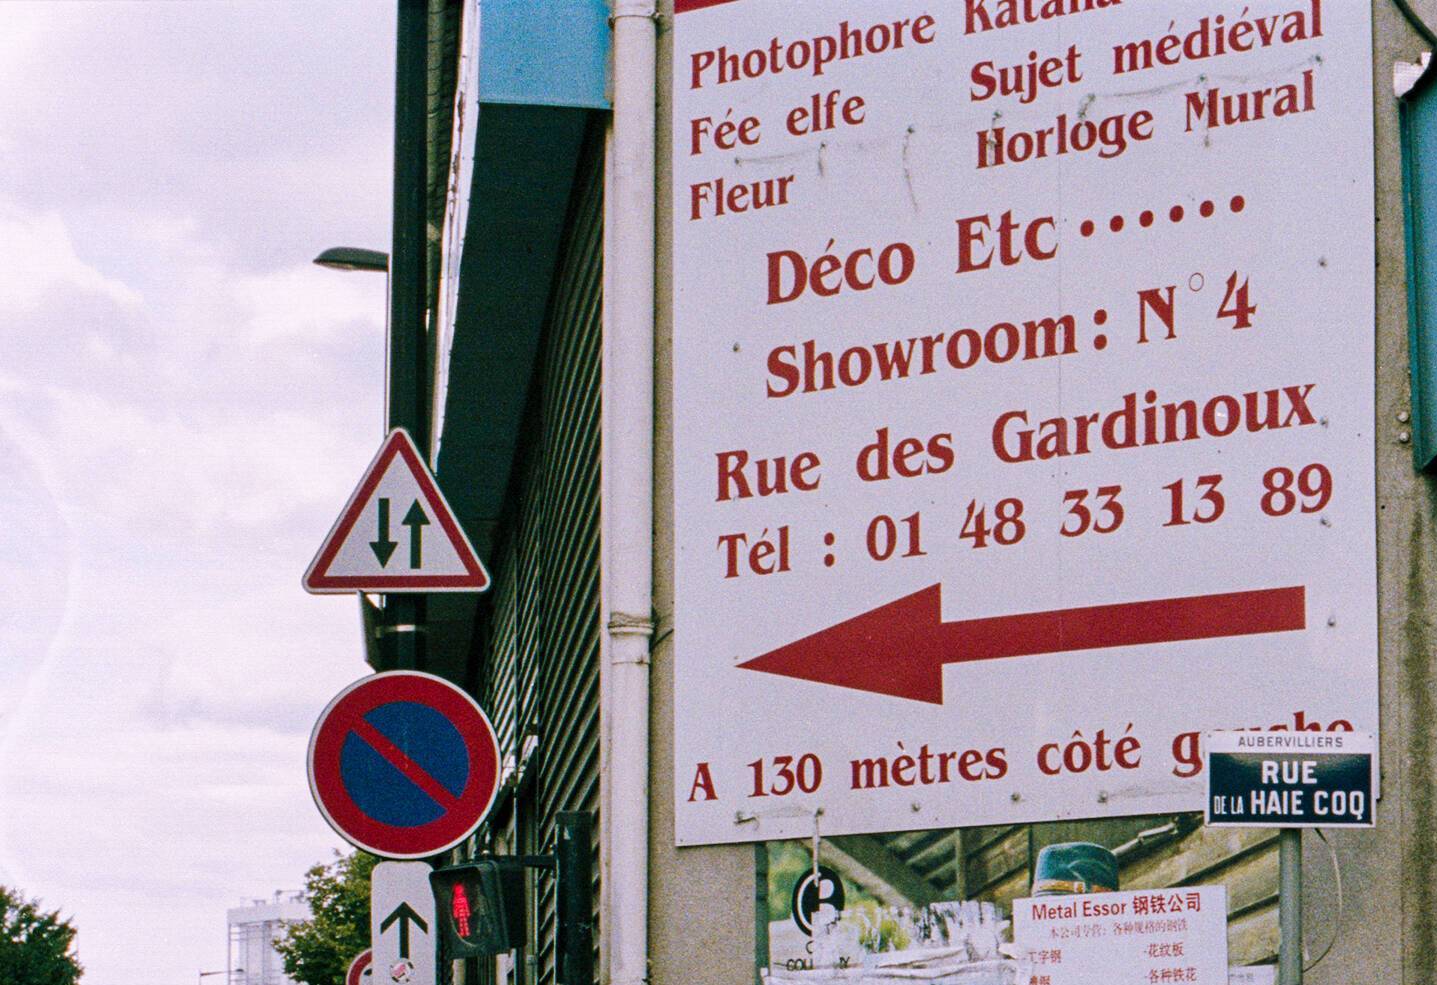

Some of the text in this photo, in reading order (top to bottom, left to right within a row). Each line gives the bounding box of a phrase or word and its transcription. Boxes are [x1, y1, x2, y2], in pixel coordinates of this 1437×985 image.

[691, 15, 935, 90] Photophore
[970, 0, 1323, 104] Sujet médiéval
[690, 91, 866, 155] Fée elfe
[977, 70, 1316, 169] Horloge Mural
[690, 175, 795, 220] Fleur
[767, 240, 916, 305] Déco
[716, 383, 1318, 502] Rue des Gardinoux
[717, 525, 792, 579] Tél
[865, 511, 928, 562] 01
[958, 498, 1026, 549] 48
[1060, 485, 1126, 538] 33
[1162, 473, 1226, 528] 13
[1260, 463, 1333, 517] 89
[687, 761, 718, 802] A
[747, 752, 823, 799] 130
[850, 744, 1009, 790] mètres
[1036, 723, 1142, 777] côté
[1238, 736, 1343, 748] AUBERVILLIERS
[1261, 760, 1318, 784] RUE
[1213, 790, 1365, 821] DE LA HAIE COQ
[1032, 892, 1201, 920] Metal Essor 钢铁公司
